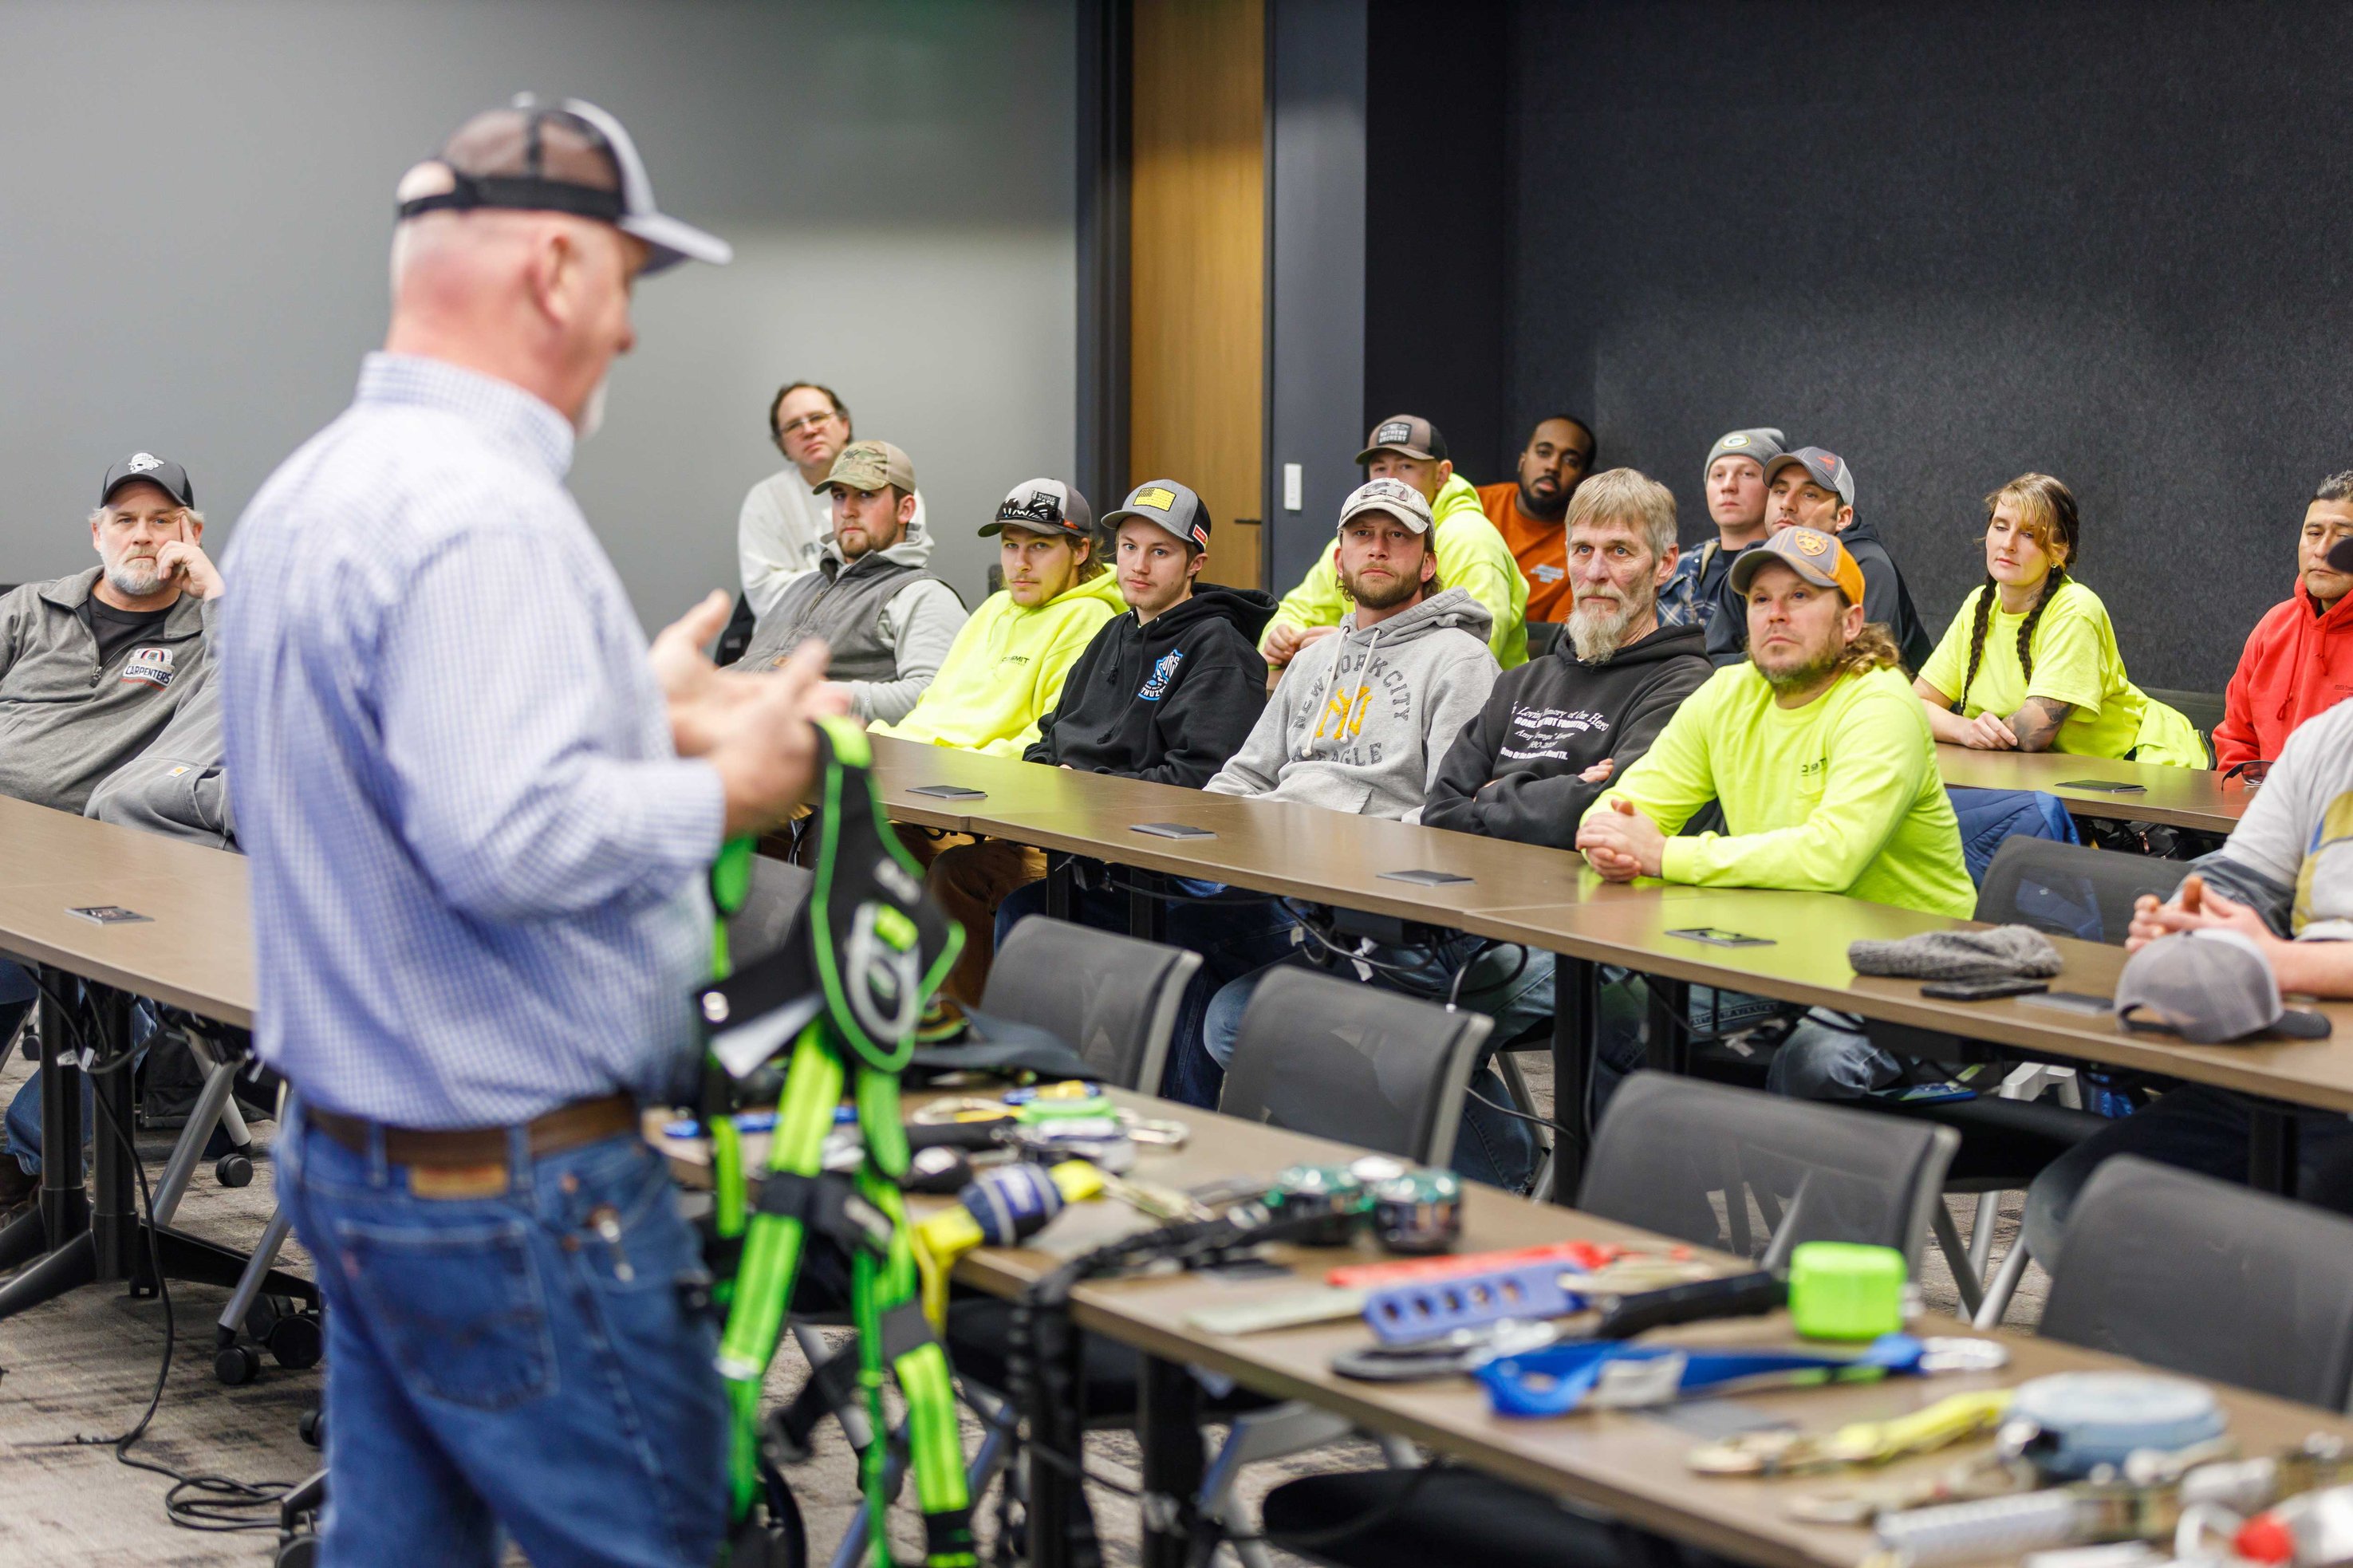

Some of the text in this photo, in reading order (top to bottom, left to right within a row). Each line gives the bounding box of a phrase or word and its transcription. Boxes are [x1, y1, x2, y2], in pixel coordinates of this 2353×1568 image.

[1038, 493, 1056, 503] THINK
[125, 665, 173, 684] CARPENTERS
[1382, 670, 1410, 722] CITY
[1586, 712, 1610, 731] Hero
